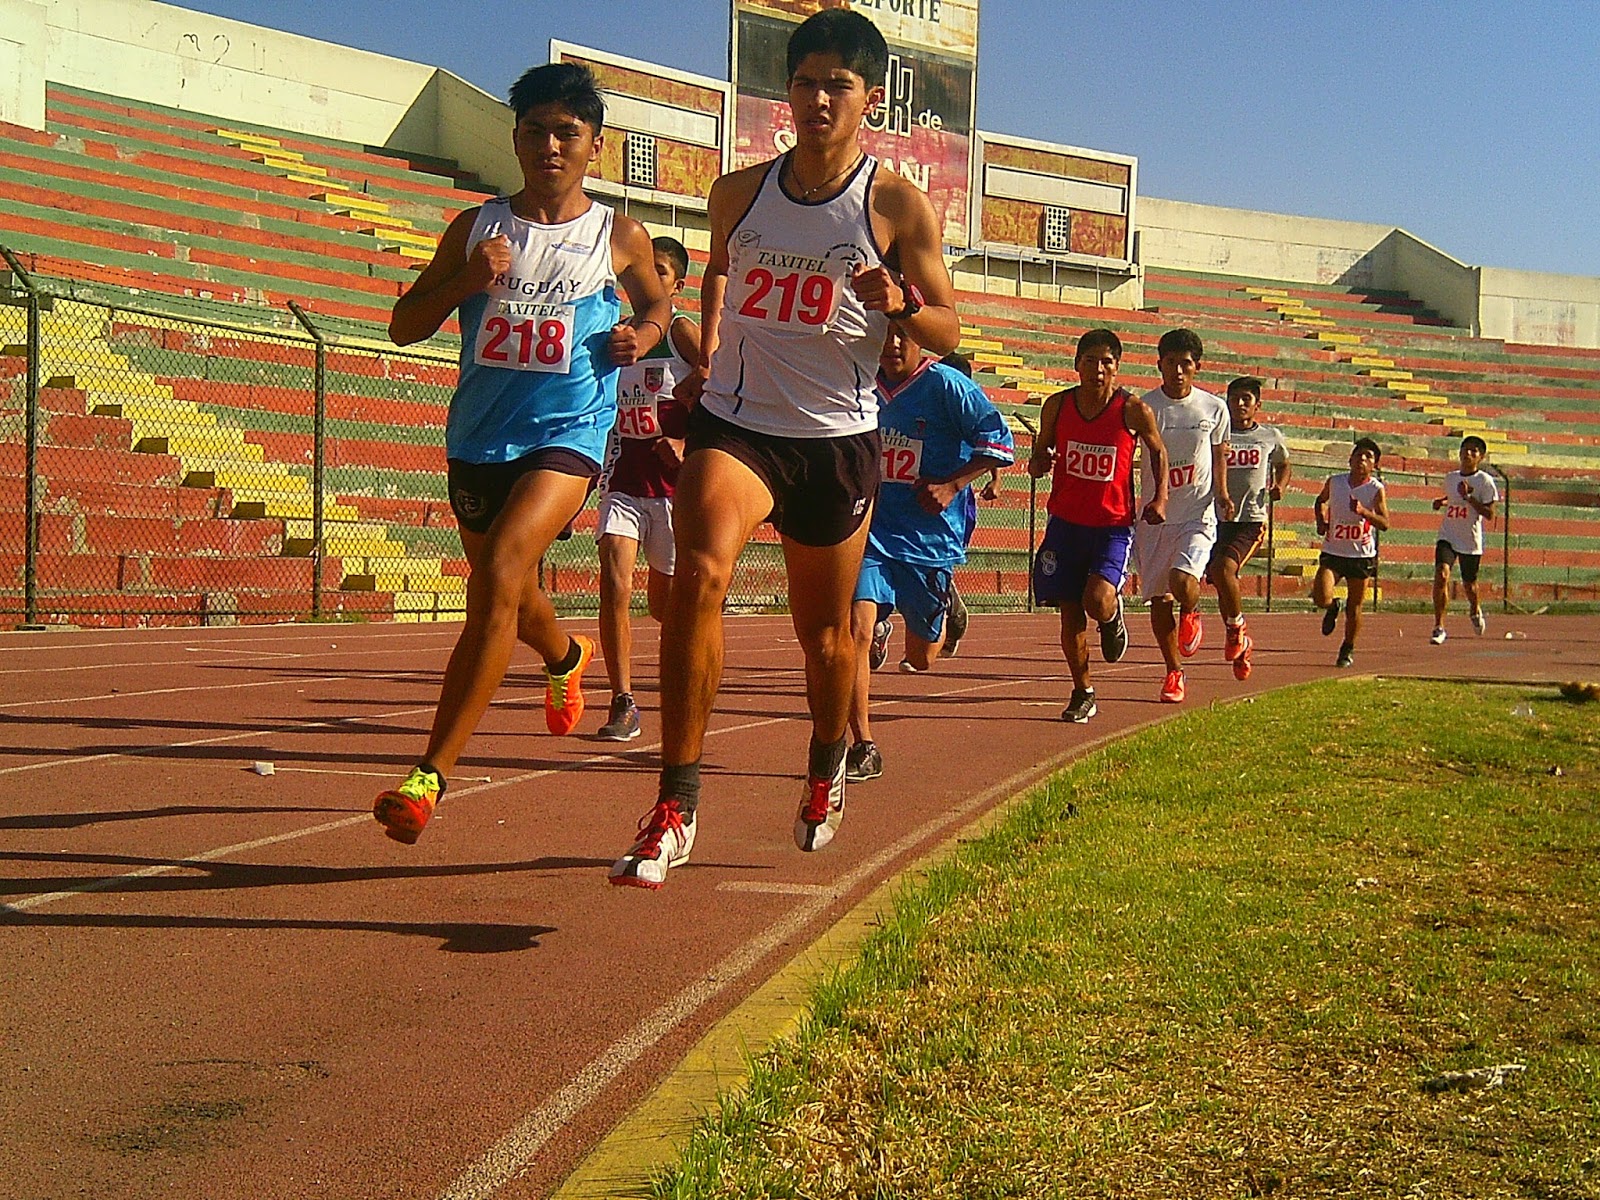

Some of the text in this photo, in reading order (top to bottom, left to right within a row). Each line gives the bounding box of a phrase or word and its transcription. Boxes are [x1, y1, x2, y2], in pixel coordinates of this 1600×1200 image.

[918, 109, 943, 131] de
[758, 251, 828, 274] TAXITEL
[495, 273, 581, 295] RUGUAY
[739, 267, 834, 326] 219
[498, 304, 560, 317] TAXITEL
[481, 316, 566, 365] 218
[618, 406, 655, 435] 215
[883, 435, 912, 448] XITEL
[1075, 443, 1108, 453] TAXITEL
[882, 447, 916, 481] 12
[1068, 450, 1114, 477] 209
[1227, 449, 1259, 466] 208
[1169, 464, 1195, 488] 07
[1447, 505, 1467, 519] 214
[1335, 524, 1361, 540] 210
